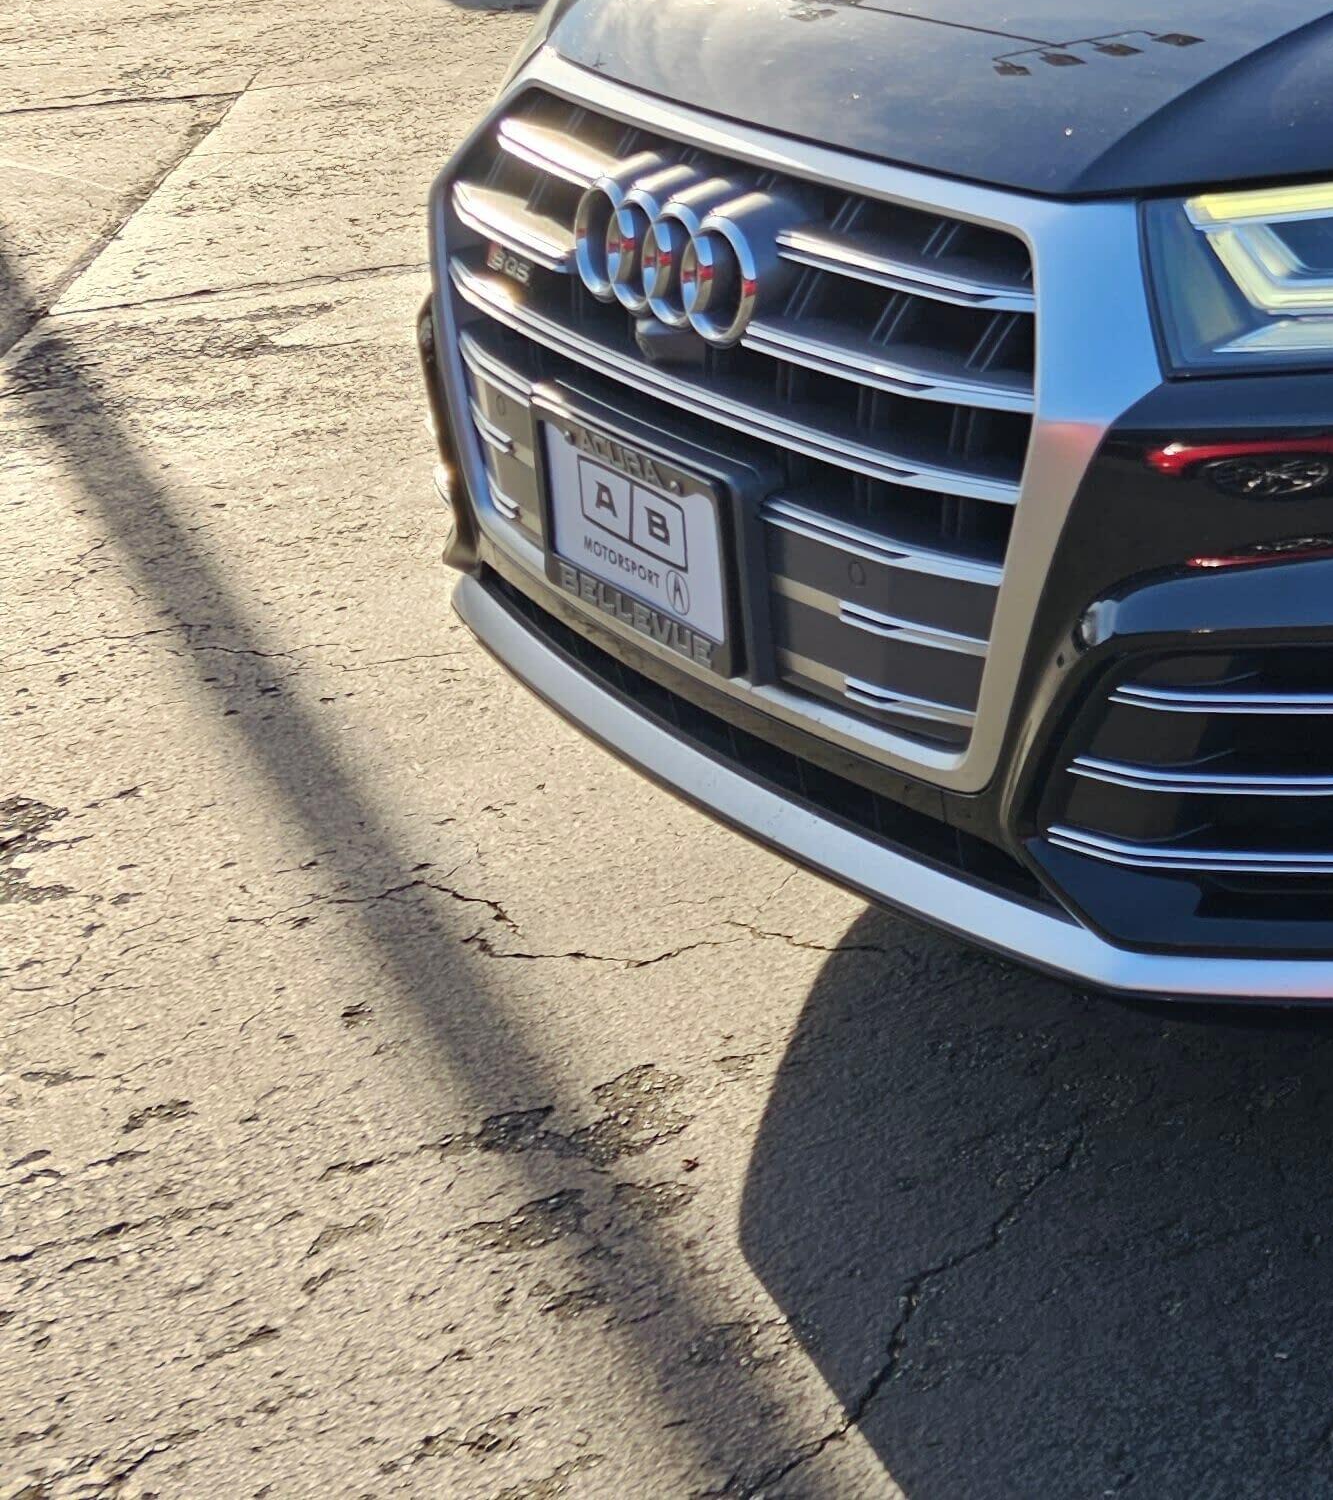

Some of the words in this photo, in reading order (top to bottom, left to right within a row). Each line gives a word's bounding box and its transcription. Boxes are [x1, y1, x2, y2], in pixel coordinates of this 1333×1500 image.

[575, 430, 664, 490] ACURA
[595, 480, 618, 519] A
[644, 506, 671, 547] B
[583, 534, 660, 589] MOTORSPORT
[559, 562, 712, 670] BELLEVUE
